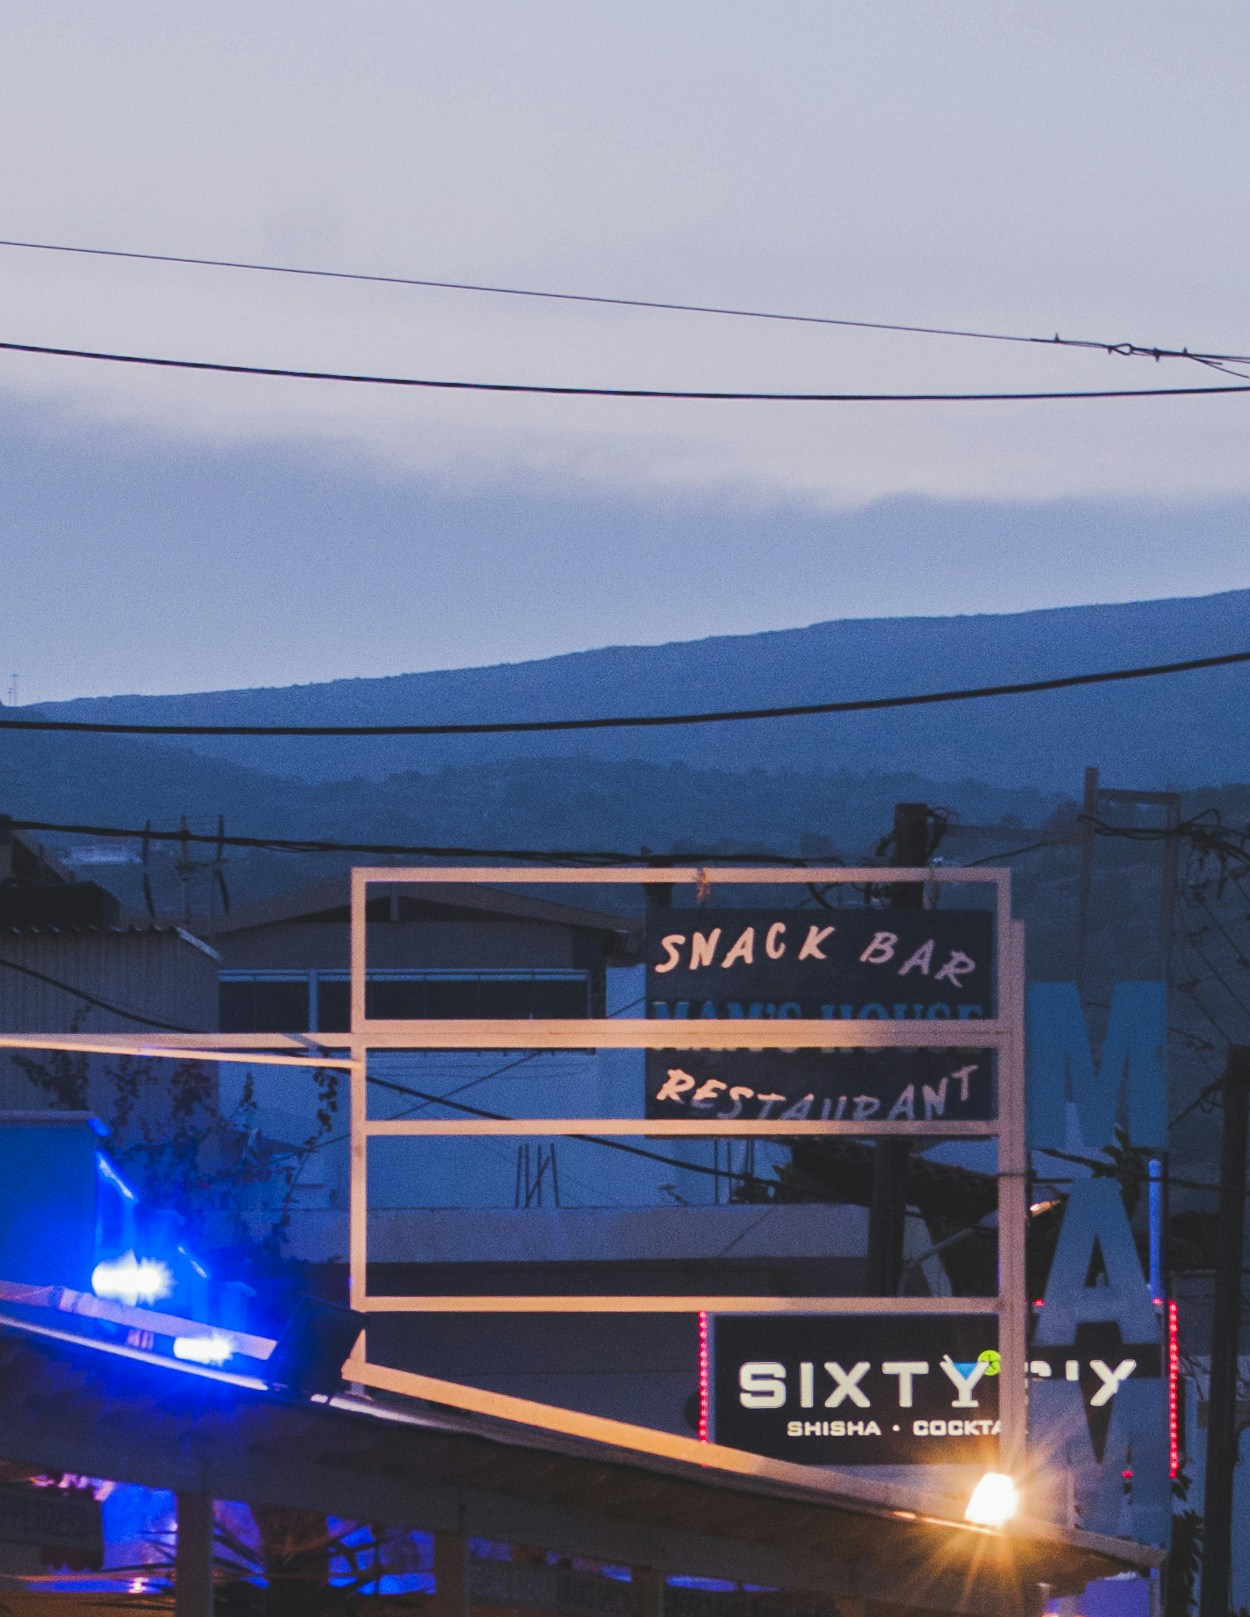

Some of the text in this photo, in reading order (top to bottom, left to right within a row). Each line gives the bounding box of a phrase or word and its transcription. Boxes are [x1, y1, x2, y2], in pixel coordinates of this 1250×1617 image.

[655, 922, 977, 989] SNACK BAR
[656, 1064, 980, 1121] RESTAURANT
[739, 1357, 990, 1409] SIXTY
[787, 1419, 1003, 1438] SHISHA COCKTA
